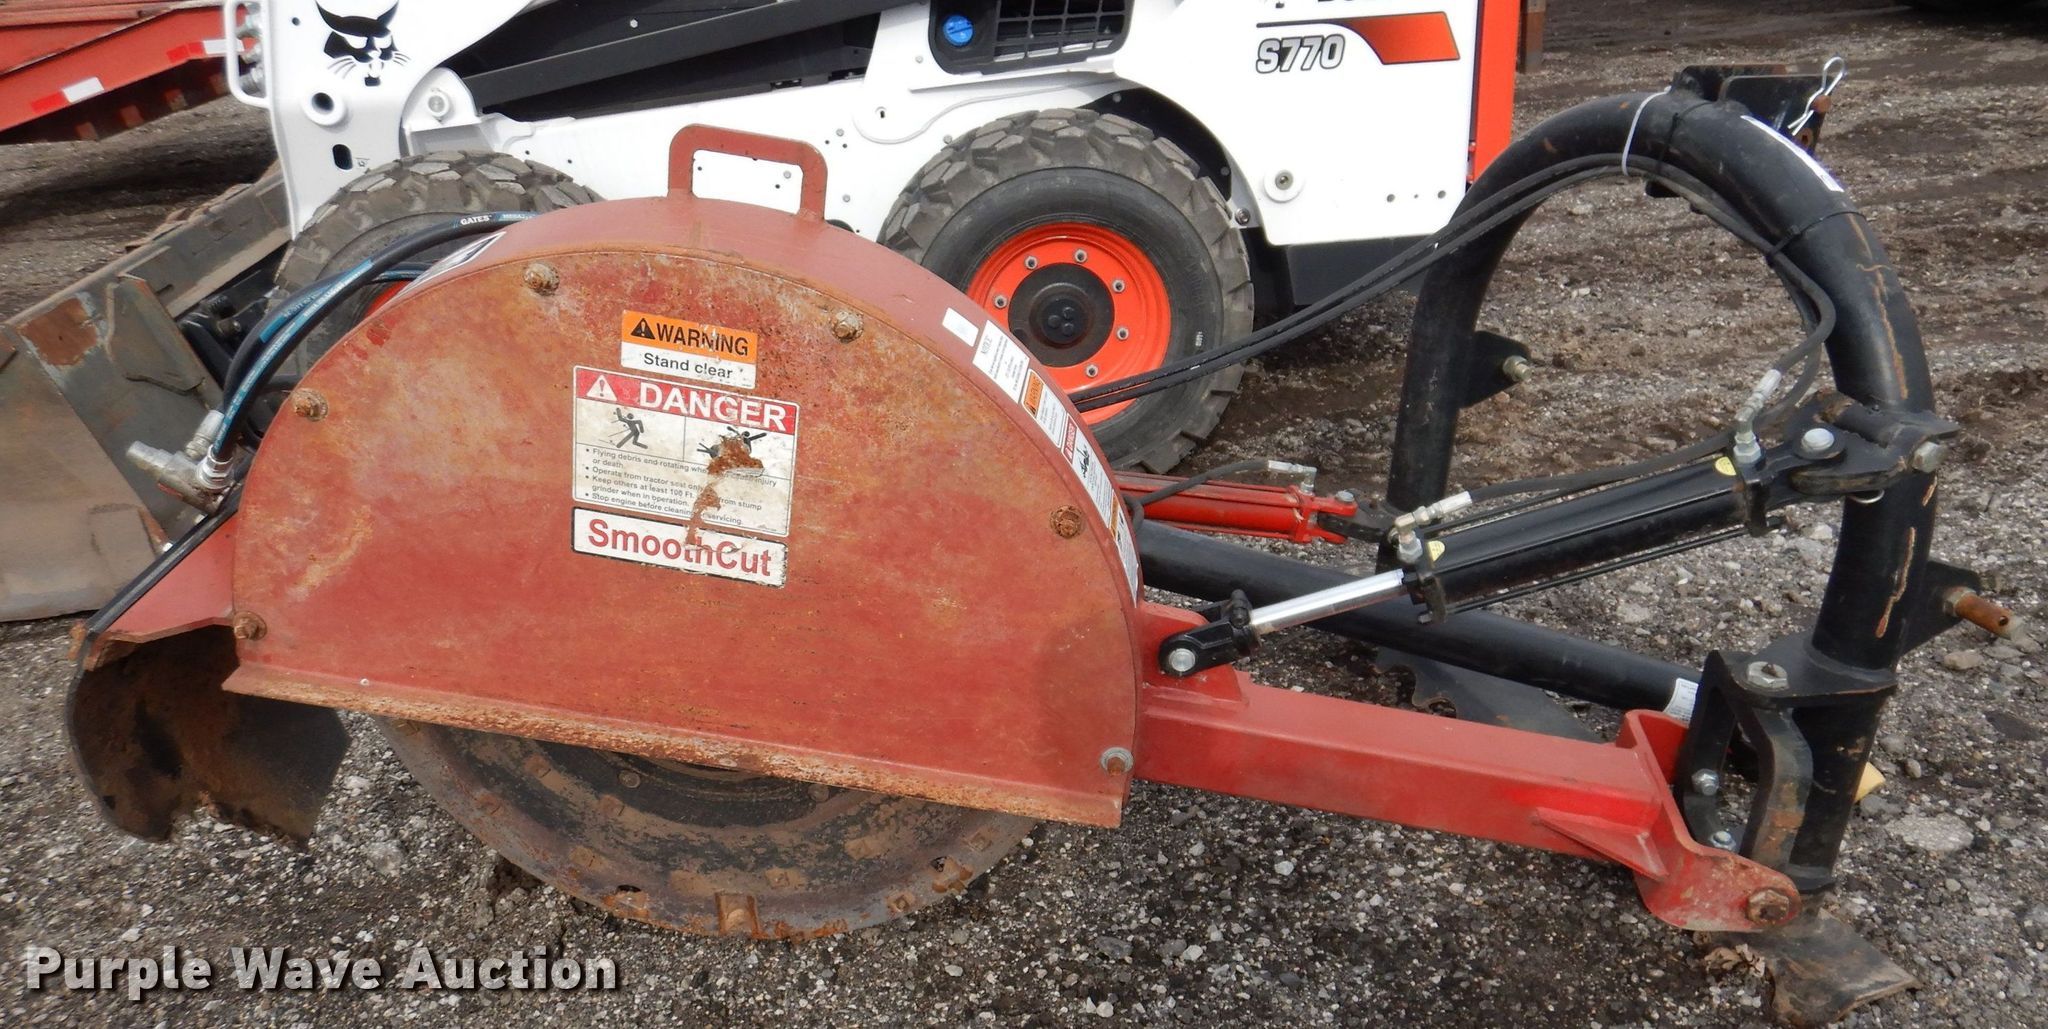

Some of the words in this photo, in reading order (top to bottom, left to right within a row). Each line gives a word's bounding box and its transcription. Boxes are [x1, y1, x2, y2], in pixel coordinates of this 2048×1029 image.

[1256, 34, 1346, 74] S770
[460, 214, 491, 226] GATES
[656, 322, 749, 356] WARNING
[643, 352, 690, 372] Stand
[694, 362, 734, 379] clear
[639, 382, 787, 432] DANGER
[592, 448, 616, 459] Flying
[617, 454, 641, 463] debris
[659, 461, 690, 473] rotating
[592, 466, 622, 477] Operate
[624, 471, 641, 480] from
[643, 474, 669, 485] tractor
[591, 484, 619, 494] grinder
[621, 489, 641, 499] when
[591, 492, 610, 502] Stop
[611, 496, 636, 506] engine
[638, 501, 662, 511] before
[663, 505, 692, 515] cleanin
[592, 475, 612, 485] Keep
[613, 479, 638, 489] others
[640, 483, 648, 491] at
[649, 484, 668, 494] least
[670, 488, 683, 497] 100
[738, 501, 762, 511] stump
[588, 518, 772, 577] SmoothCut
